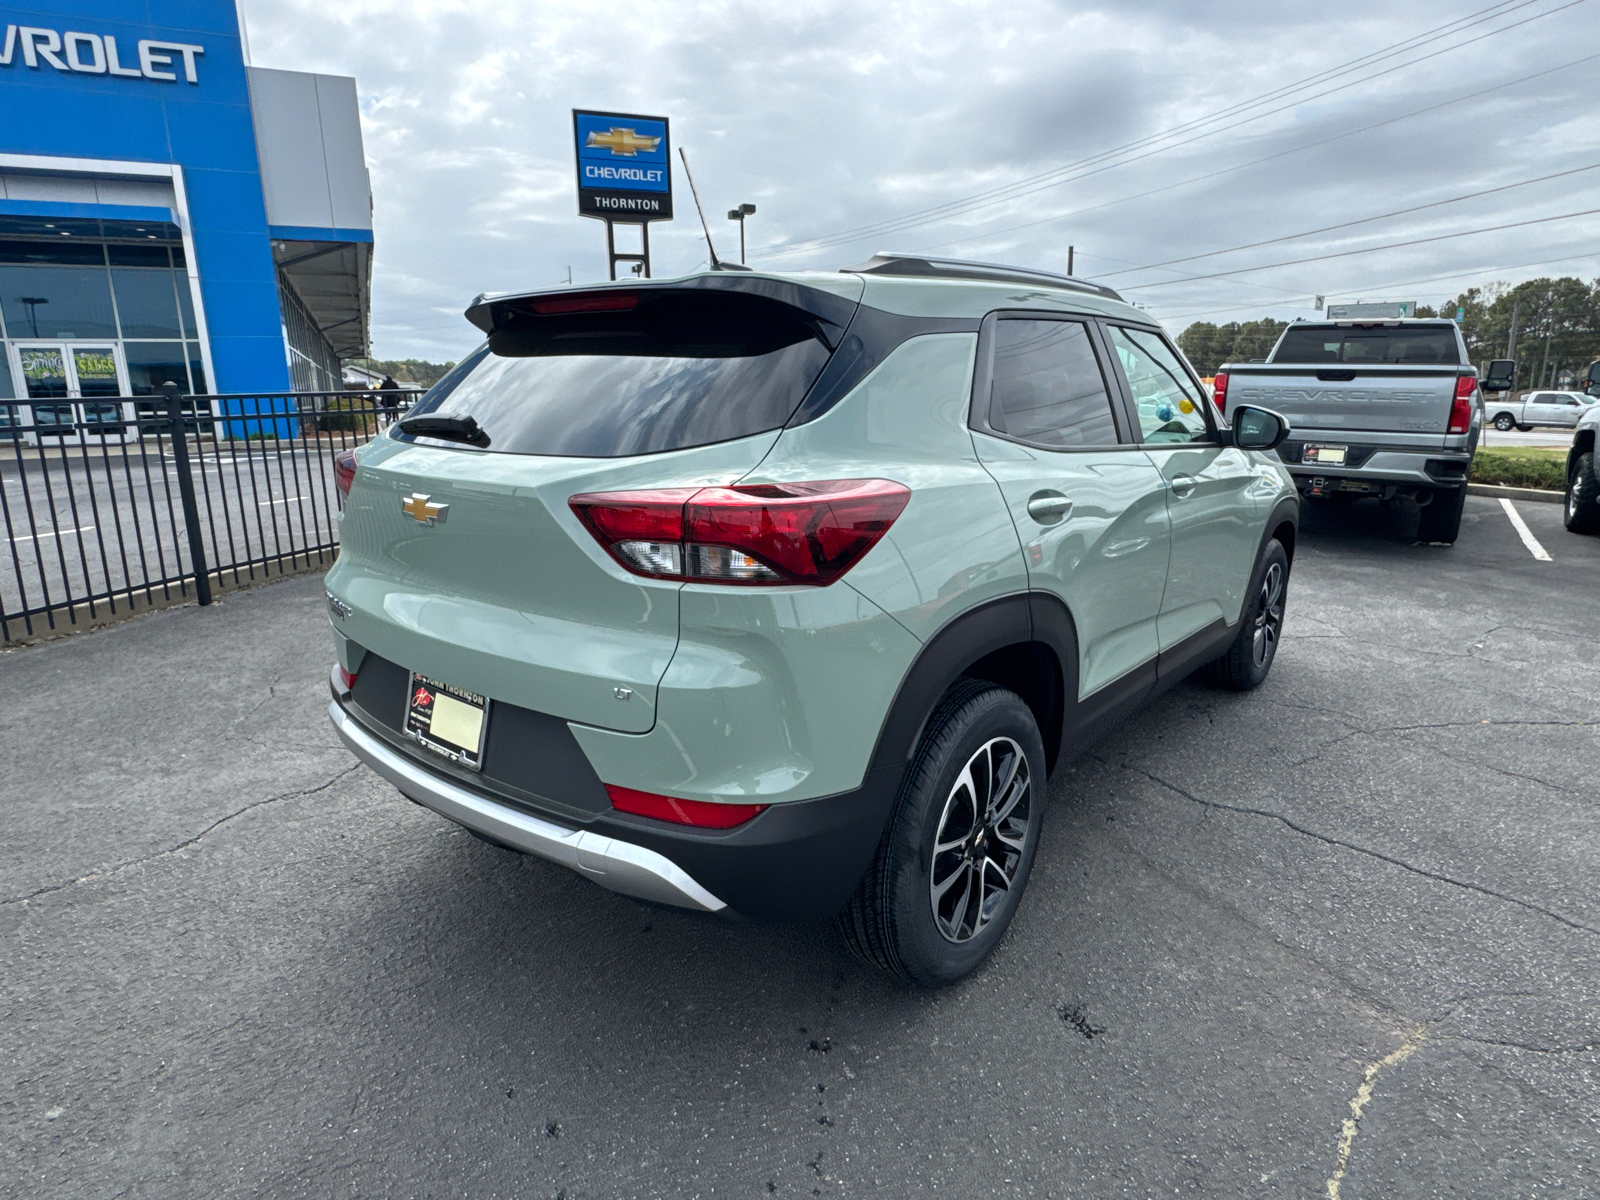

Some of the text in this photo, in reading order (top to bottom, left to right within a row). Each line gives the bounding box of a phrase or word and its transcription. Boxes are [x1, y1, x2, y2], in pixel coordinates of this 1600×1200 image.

[585, 165, 663, 182] CHEVROLET
[594, 196, 659, 211] THORNTON
[1240, 388, 1437, 404] CHEVROLET
[613, 687, 633, 700] LT
